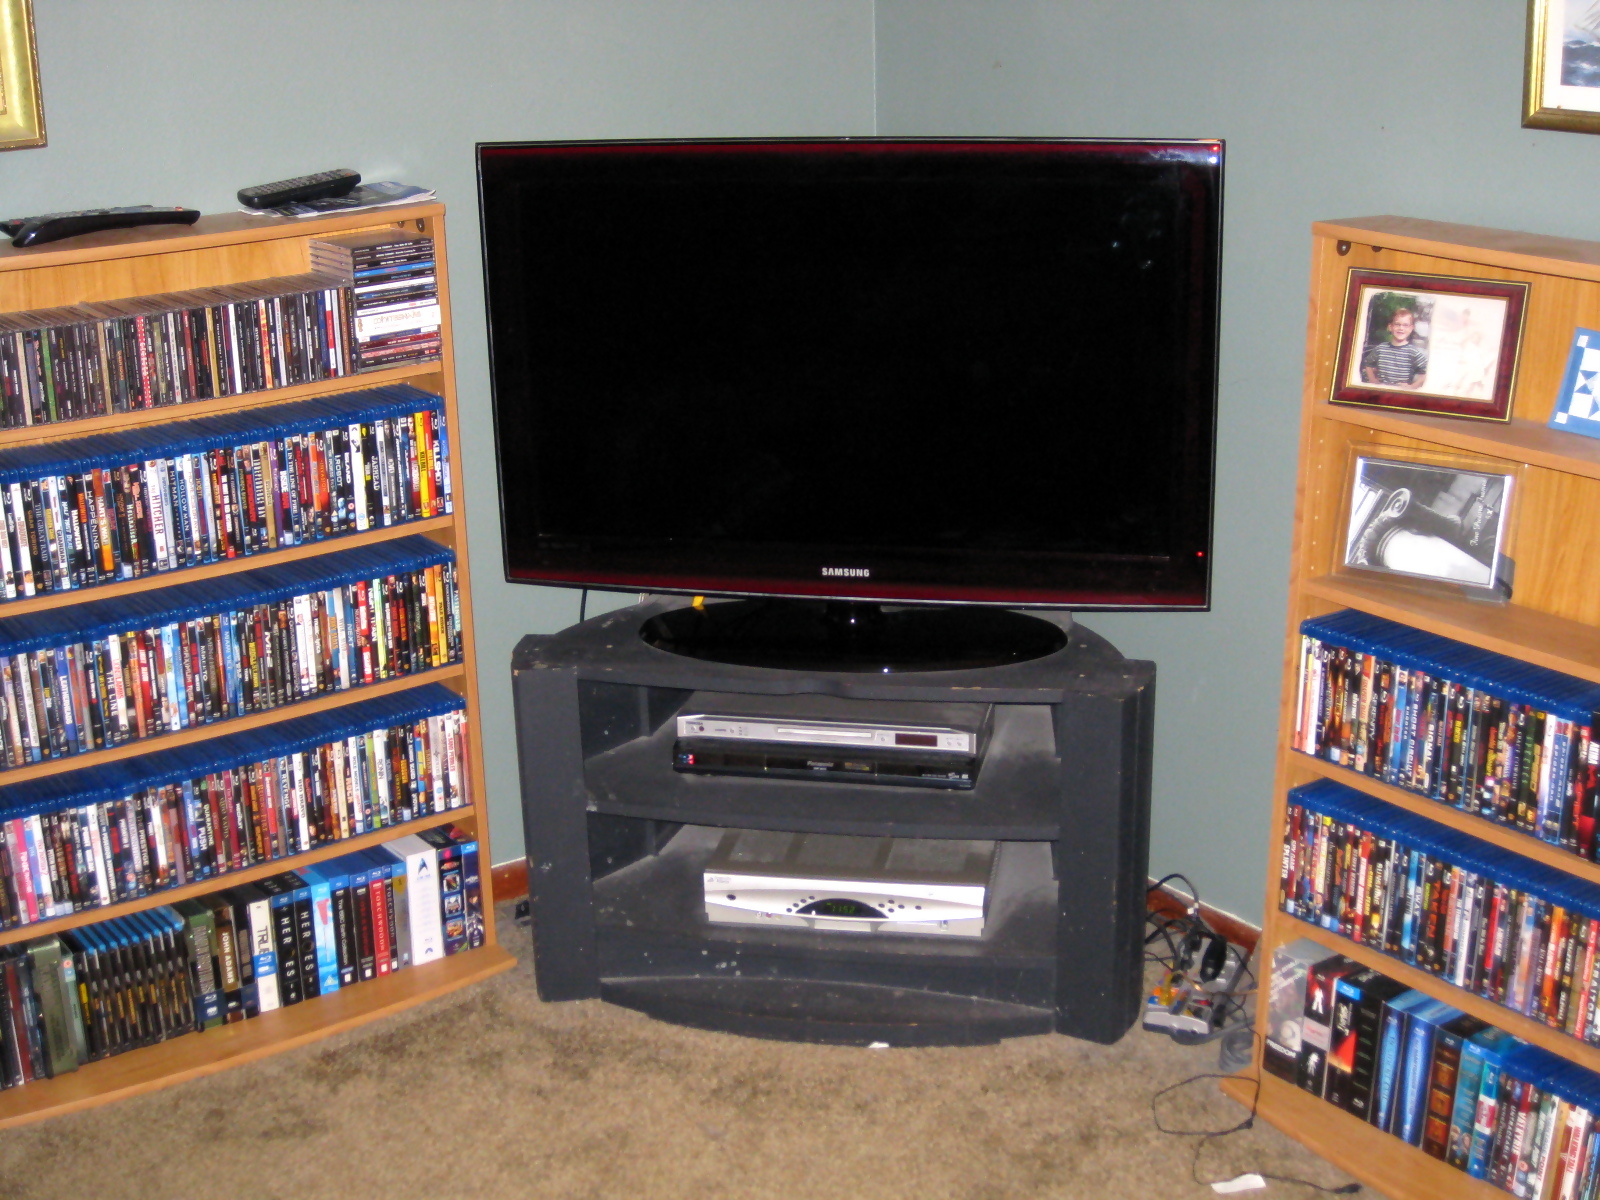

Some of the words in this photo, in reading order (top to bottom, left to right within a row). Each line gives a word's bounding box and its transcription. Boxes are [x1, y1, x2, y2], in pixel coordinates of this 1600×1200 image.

[372, 456, 380, 490] JARHEAD
[433, 440, 442, 486] KILLSHOT
[169, 471, 178, 506] HITMAN
[179, 479, 187, 512] HOLLOW
[253, 459, 264, 504] INDEPENDENCE
[87, 491, 100, 550] HAPPENING
[98, 496, 107, 526] HART'S
[152, 495, 164, 535] HITCHER
[30, 531, 38, 555] TORINO
[37, 520, 45, 542] GREAT
[57, 530, 65, 563] GUARDIAN
[71, 510, 82, 550] HALLOWEEN
[822, 567, 870, 577] SAMSUNG
[106, 670, 114, 689] THE
[183, 647, 192, 683] MAXIMUM
[60, 675, 72, 724] LEATHERHEADS
[109, 694, 118, 716] LINE
[1369, 693, 1378, 740] SERENITY
[1410, 703, 1419, 736] SHORT
[1426, 724, 1434, 762] SIGNAL
[282, 774, 290, 808] REVENGE
[345, 778, 353, 803] ROCK
[198, 827, 207, 850] PUSH
[203, 804, 214, 846] QUARANTINE
[139, 830, 148, 866] PRESTIGE
[1281, 844, 1290, 879] SPLINTER
[1373, 863, 1383, 905] SUNSHINE
[221, 932, 231, 953] JOHN
[341, 939, 349, 965] Collection
[223, 955, 234, 984] ADAMS
[1586, 962, 1600, 1021] TRAITOR
[1537, 1155, 1546, 1181] POINT
